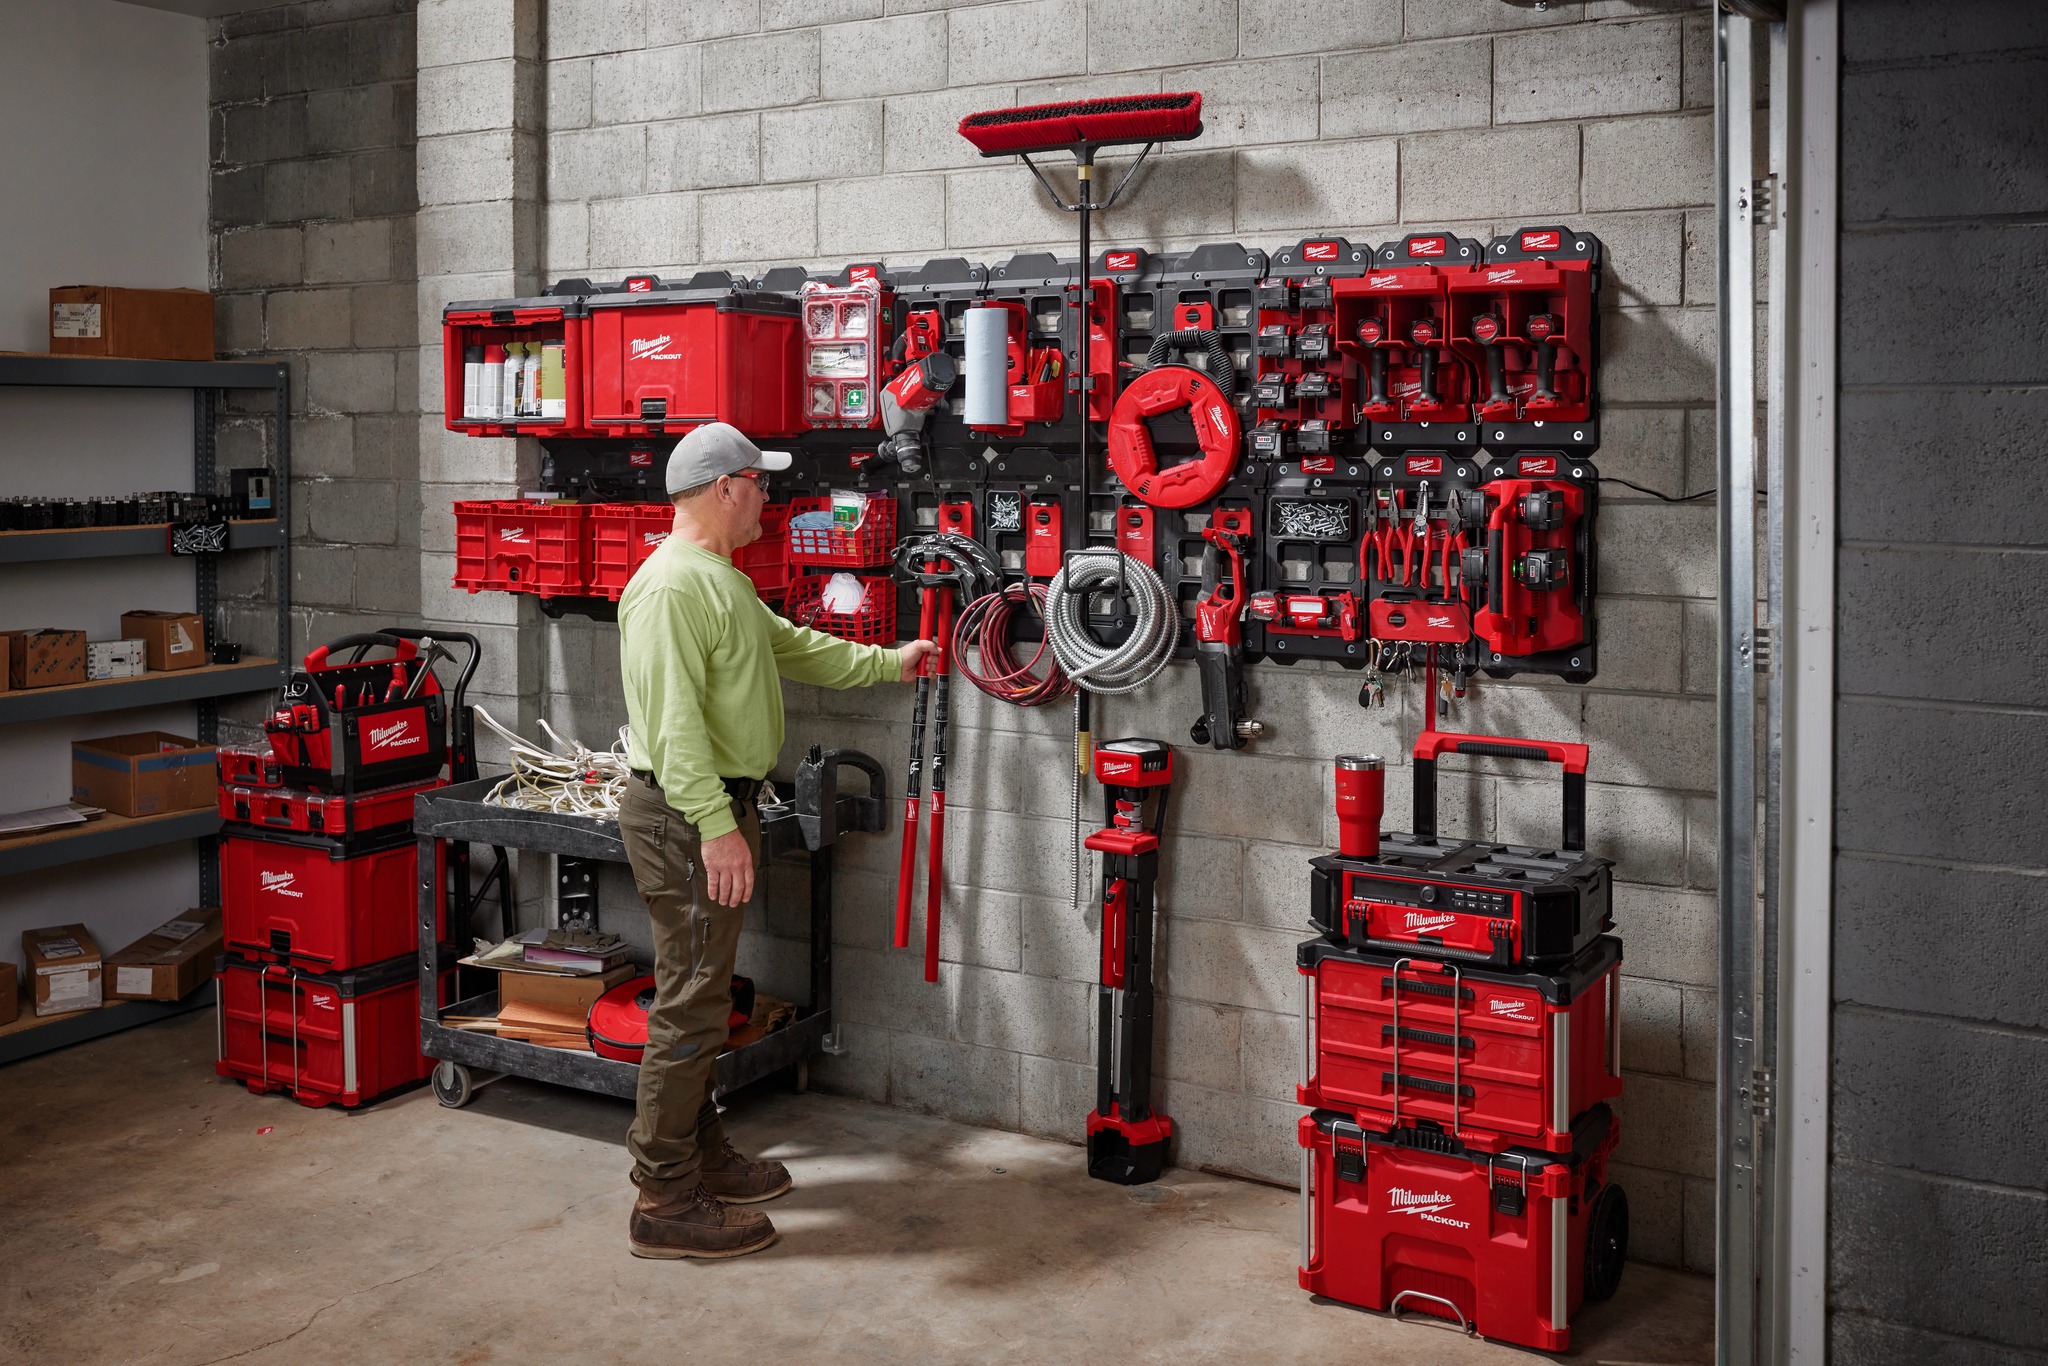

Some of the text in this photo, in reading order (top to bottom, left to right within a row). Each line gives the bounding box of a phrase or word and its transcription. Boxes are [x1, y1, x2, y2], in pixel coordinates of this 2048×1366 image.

[1411, 240, 1437, 251] Milwaukee
[1523, 235, 1551, 245] Milwaukee
[1305, 245, 1330, 255] Milwaukee
[1488, 269, 1516, 280] Milwaukee
[1369, 275, 1397, 286] Milwaukee
[630, 334, 671, 355] Milwaukee
[1211, 405, 1228, 435] Milwaukee
[1409, 459, 1434, 469] Milwaukee
[1521, 460, 1547, 469] Milwaukee
[1200, 608, 1211, 638] Milwaukee
[369, 720, 409, 744] Milwaukee
[390, 736, 420, 747] PACKOUT
[1102, 762, 1132, 772] Milwaukee
[260, 871, 294, 886] Milwaukee
[277, 889, 303, 898] PACKOUT
[1404, 912, 1456, 928] Milwaukee
[1489, 1000, 1525, 1011] Milwaukee
[1507, 1013, 1535, 1021] PACKOUT
[1387, 1187, 1452, 1206] Milwaukee
[1420, 1213, 1471, 1229] PACKOUT
